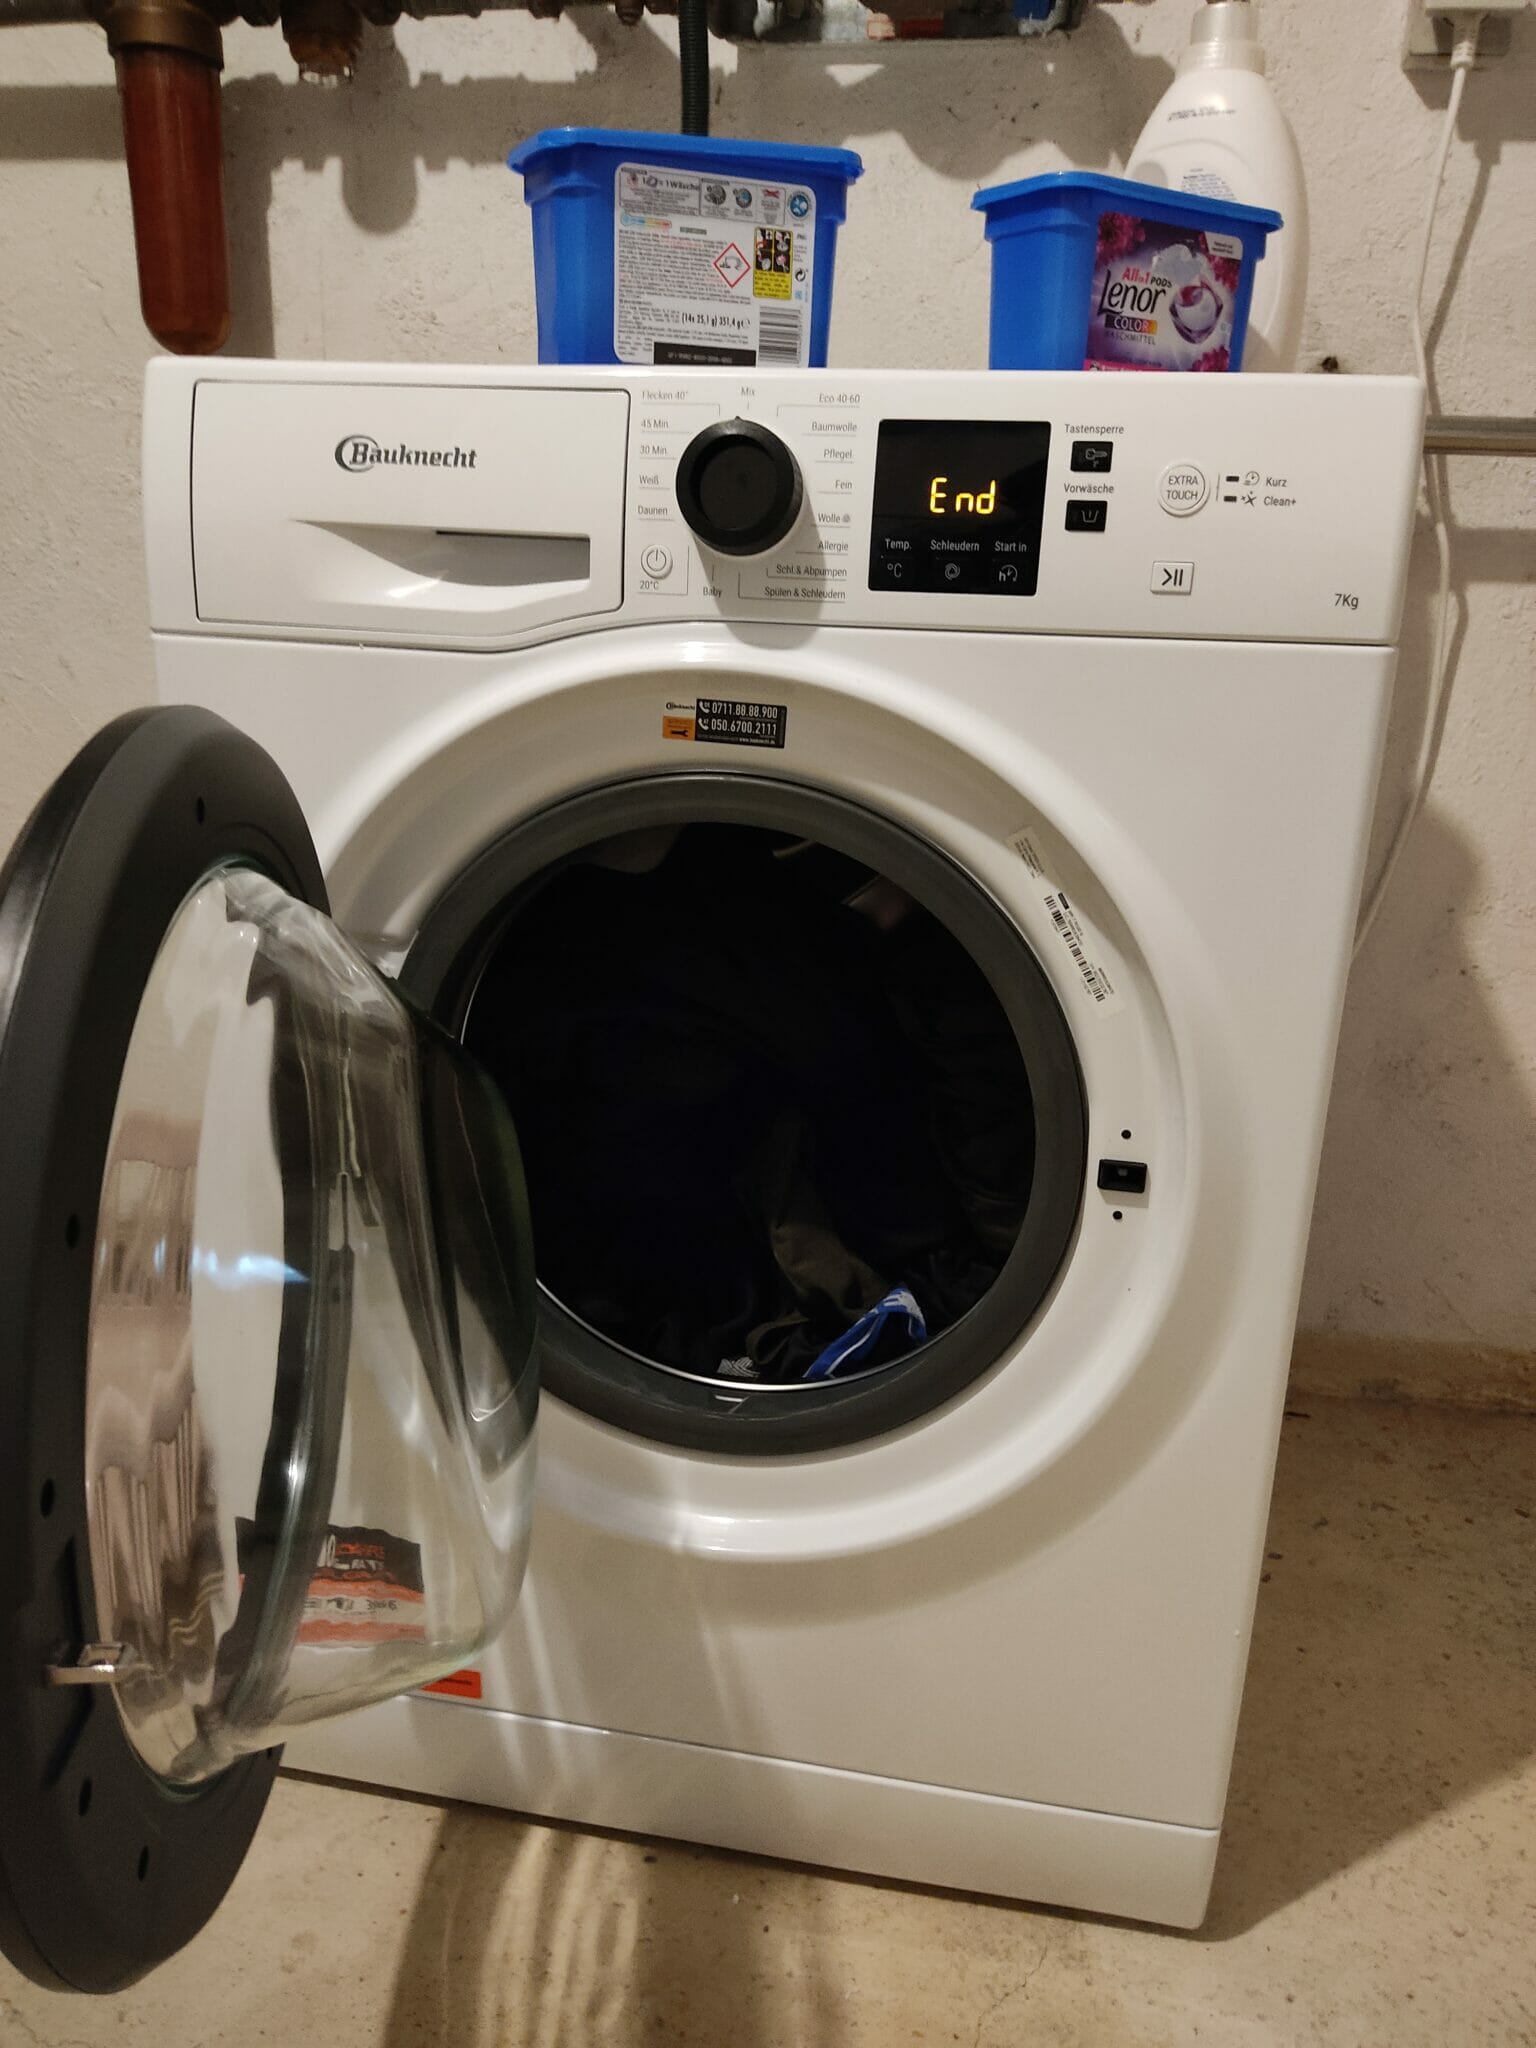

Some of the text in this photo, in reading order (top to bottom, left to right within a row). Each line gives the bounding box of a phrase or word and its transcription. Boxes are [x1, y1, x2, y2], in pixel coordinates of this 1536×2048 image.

[1097, 269, 1167, 316] Lenor
[1113, 316, 1150, 334] COLOR
[641, 390, 674, 401] Flecken
[740, 386, 755, 396] Mix
[818, 393, 835, 404] Eco
[640, 419, 652, 429] 45
[811, 420, 858, 432] Baumwolle
[1064, 423, 1125, 435] Tastensperre
[340, 438, 478, 471] Bauknecht
[639, 445, 651, 455] 30
[638, 473, 660, 486] Weiß
[834, 479, 853, 490] Fein
[1168, 475, 1199, 486] EXTRA
[1265, 477, 1288, 488] Kurz
[1063, 483, 1114, 495] Vorwäsche
[929, 477, 996, 514] End
[1166, 490, 1199, 501] TOUCH
[1263, 496, 1297, 507] Clean+
[637, 505, 669, 517] Daunen
[817, 512, 842, 524] Wolle
[817, 541, 849, 555] Allergie
[884, 538, 912, 551] Temp.
[930, 539, 980, 552] Schleudern
[994, 541, 1028, 552] Start in
[803, 565, 848, 578] Abpumpen
[639, 579, 660, 591] 20°C
[702, 585, 722, 599] Baby
[764, 586, 846, 600] Spülen & Schleudern
[1334, 593, 1359, 610] 7Kg
[711, 701, 778, 719] 0711.88.88.900
[711, 717, 777, 736] 050.6700.2111
